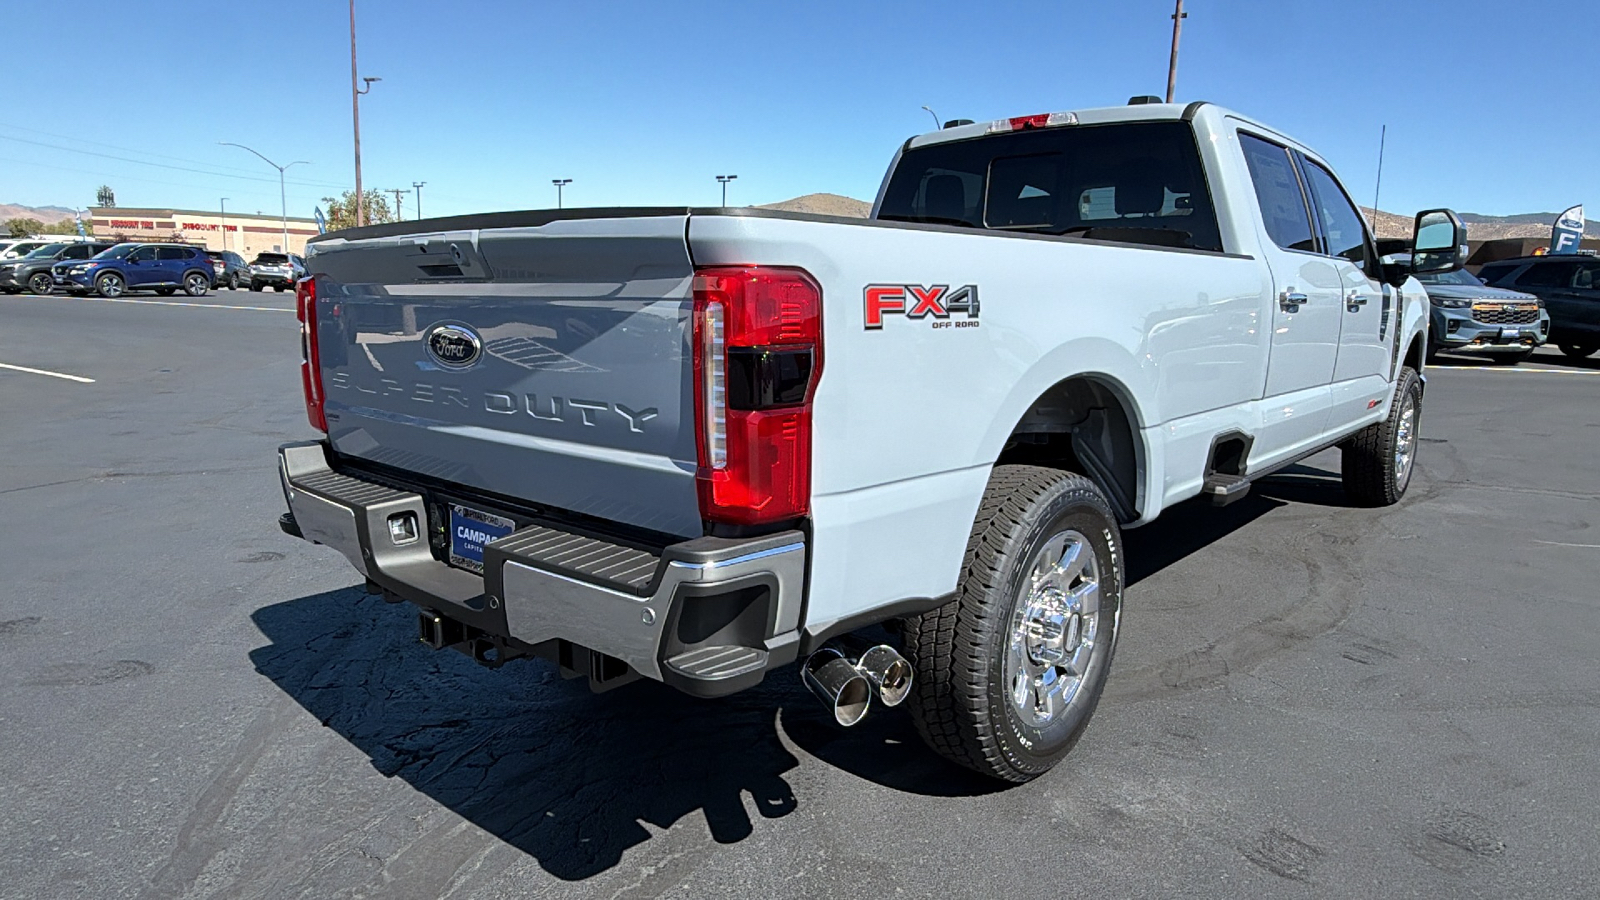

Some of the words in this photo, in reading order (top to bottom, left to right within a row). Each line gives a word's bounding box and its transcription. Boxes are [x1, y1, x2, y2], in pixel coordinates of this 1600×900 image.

[182, 222, 220, 231] DISCOUNT
[863, 283, 980, 330] FX4
[932, 321, 952, 329] OFF
[954, 320, 980, 329] ROAD
[434, 332, 466, 358] Ford
[332, 371, 469, 408] SUPER
[484, 392, 658, 433] DUTY
[457, 526, 498, 544] CAMPA
[464, 542, 483, 553] CAPITA
